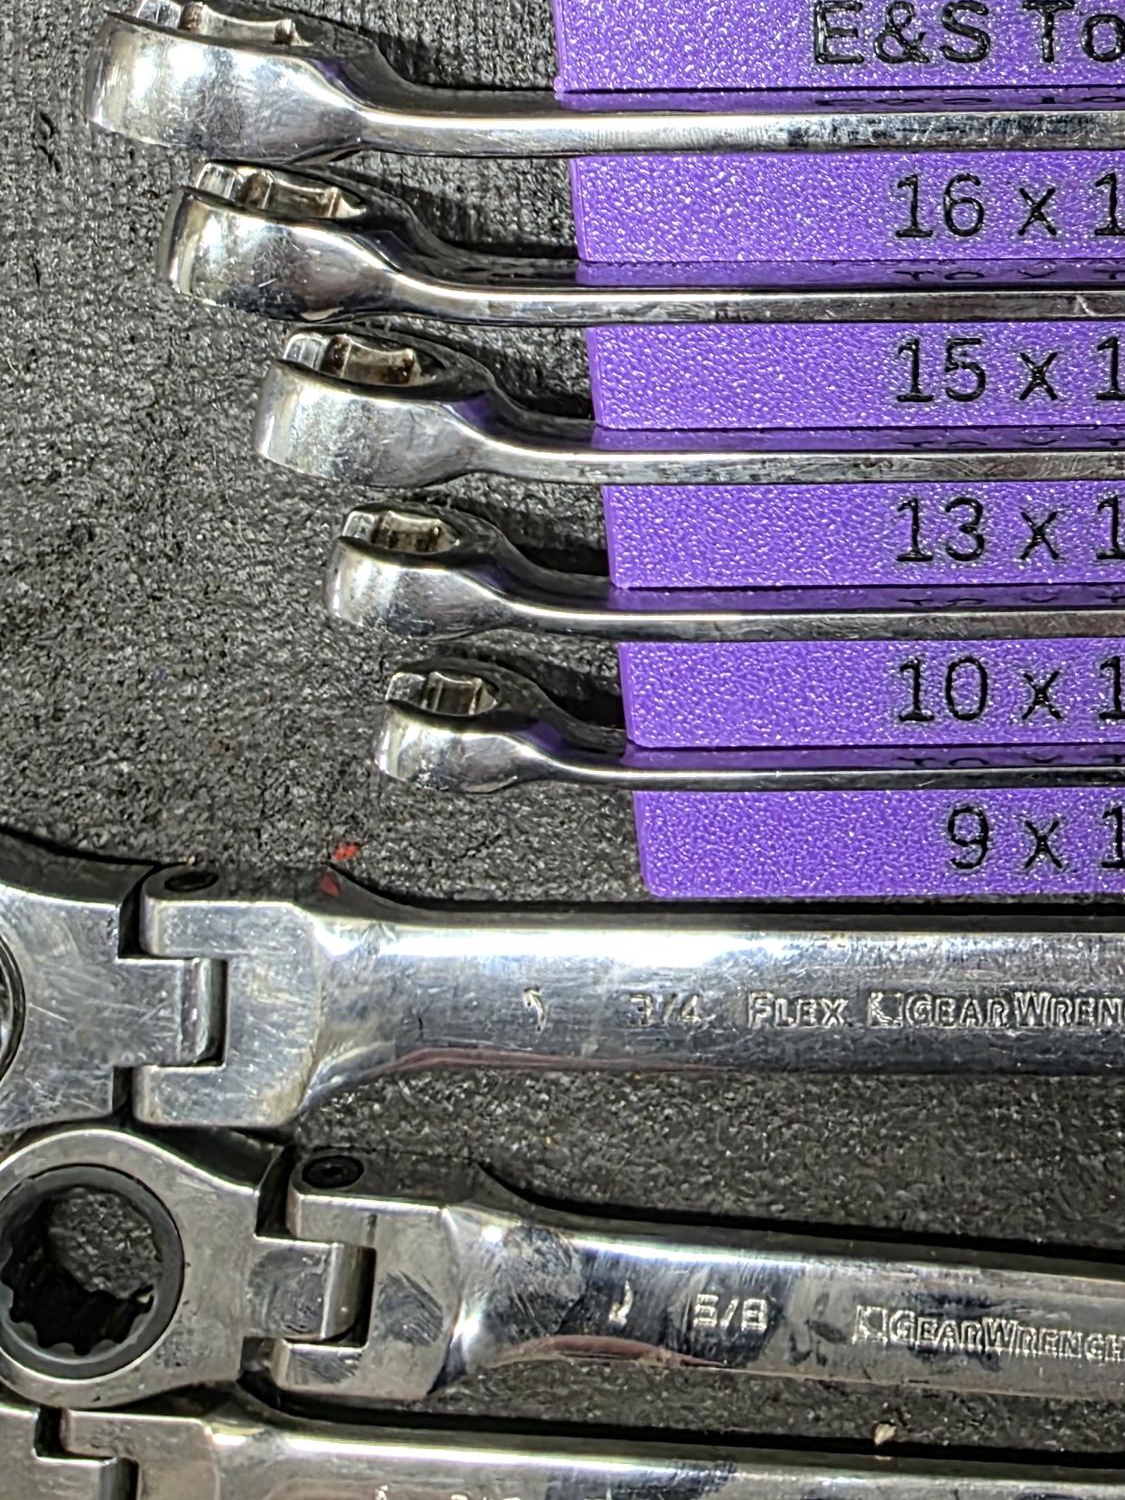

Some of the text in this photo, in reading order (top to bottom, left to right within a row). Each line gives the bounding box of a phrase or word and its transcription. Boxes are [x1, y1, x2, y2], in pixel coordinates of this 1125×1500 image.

[812, 0, 991, 65] E&S
[895, 173, 984, 238] 16
[1018, 187, 1057, 236] x
[896, 337, 986, 402] 15
[1019, 351, 1058, 401] x
[896, 497, 985, 562] 13
[1020, 511, 1060, 561] x
[898, 656, 988, 722] 10
[1022, 670, 1062, 720] x
[949, 806, 989, 869] 9
[1024, 820, 1063, 868] x
[628, 992, 702, 1027] 3/4
[693, 1293, 768, 1333] 5/8
